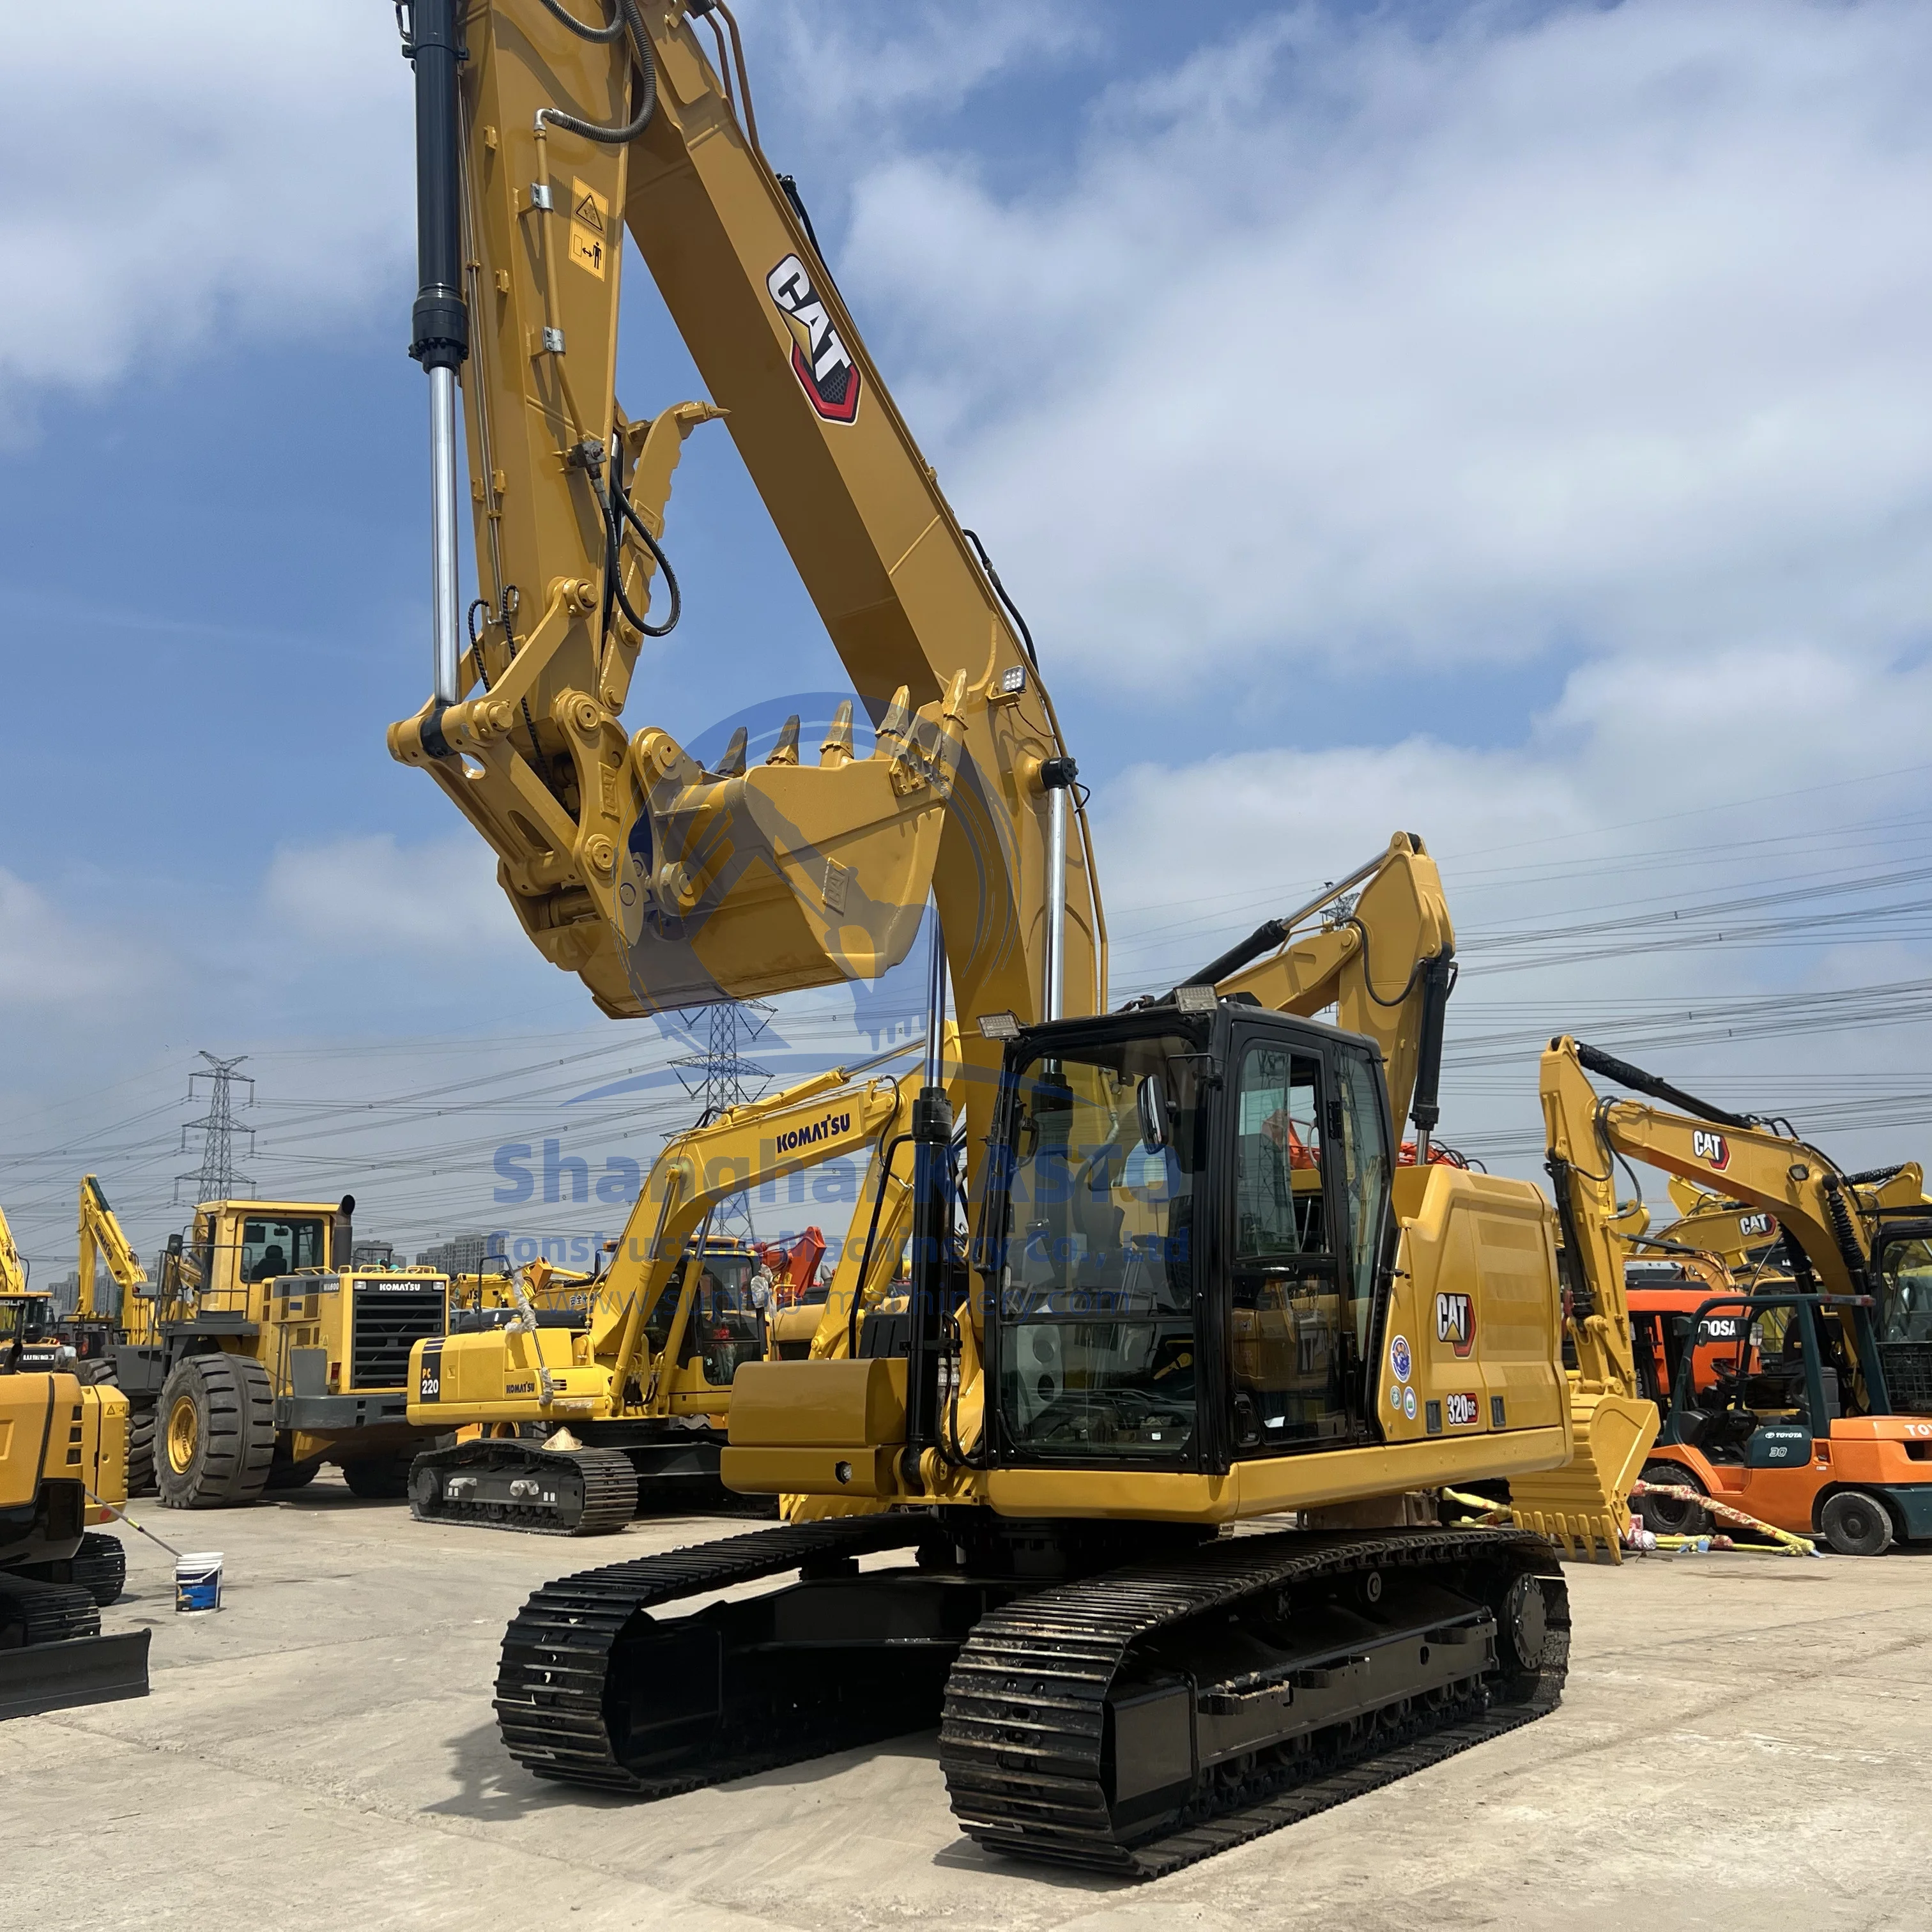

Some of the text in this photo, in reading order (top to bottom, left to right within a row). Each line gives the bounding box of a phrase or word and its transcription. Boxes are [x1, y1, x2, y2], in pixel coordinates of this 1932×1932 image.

[768, 254, 852, 382] CAT
[776, 1113, 850, 1153] KOMATSU
[1693, 1130, 1721, 1161] CAT
[1739, 1213, 1768, 1236] CAT
[379, 1282, 421, 1291] KOMATSU
[1436, 1293, 1468, 1341] CAT
[422, 1367, 431, 1379] PC
[422, 1379, 439, 1395] 220
[506, 1381, 535, 1394] KOMATSU
[1447, 1394, 1468, 1423] 320
[1904, 1423, 1932, 1436] TO
[1768, 1446, 1788, 1458] 30
